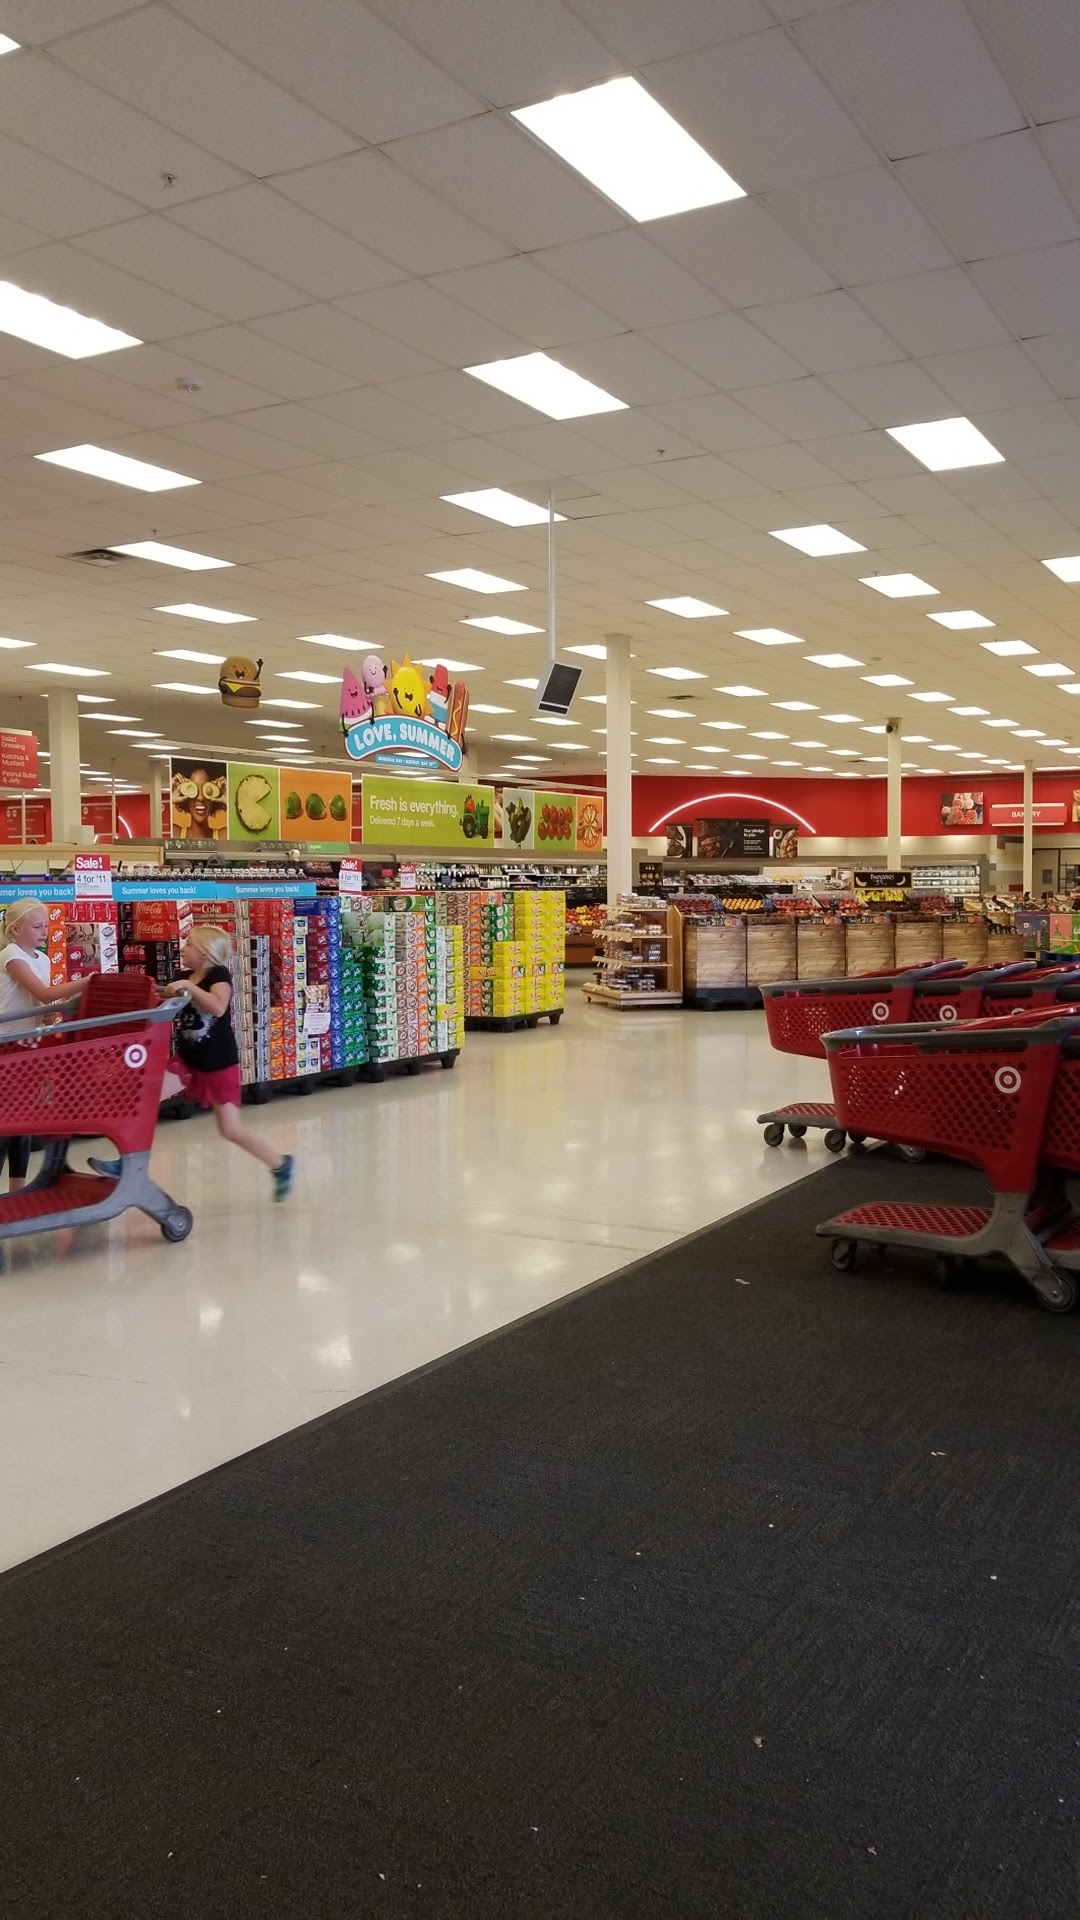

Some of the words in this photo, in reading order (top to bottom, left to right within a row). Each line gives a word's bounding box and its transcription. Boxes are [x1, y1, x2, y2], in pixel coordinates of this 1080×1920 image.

[2, 742, 26, 751] Dressing
[354, 723, 397, 751] LOVE,
[400, 723, 455, 761] SUMMER
[2, 753, 24, 761] Ketchup
[2, 770, 21, 778] Peanut
[9, 777, 21, 785] Jelly
[370, 795, 397, 811] Fresh
[400, 797, 408, 812] is
[409, 801, 459, 818] everything.
[370, 816, 396, 826] Delivered
[397, 818, 401, 826] 7
[402, 818, 415, 829] days
[420, 819, 435, 828] week.
[76, 857, 103, 870] Sale!
[341, 859, 358, 871] Sale!
[77, 874, 82, 882] 4
[84, 874, 95, 883] for
[17, 887, 37, 897] loves
[39, 889, 53, 899] you
[54, 888, 74, 896] back!
[122, 887, 149, 895] Summer
[150, 886, 167, 894] loves
[168, 887, 179, 895] you
[179, 886, 197, 894] back!
[235, 885, 259, 893] Summer
[259, 885, 274, 893] loves
[275, 886, 285, 894] you
[285, 885, 300, 893] back!
[201, 903, 222, 914] Coke
